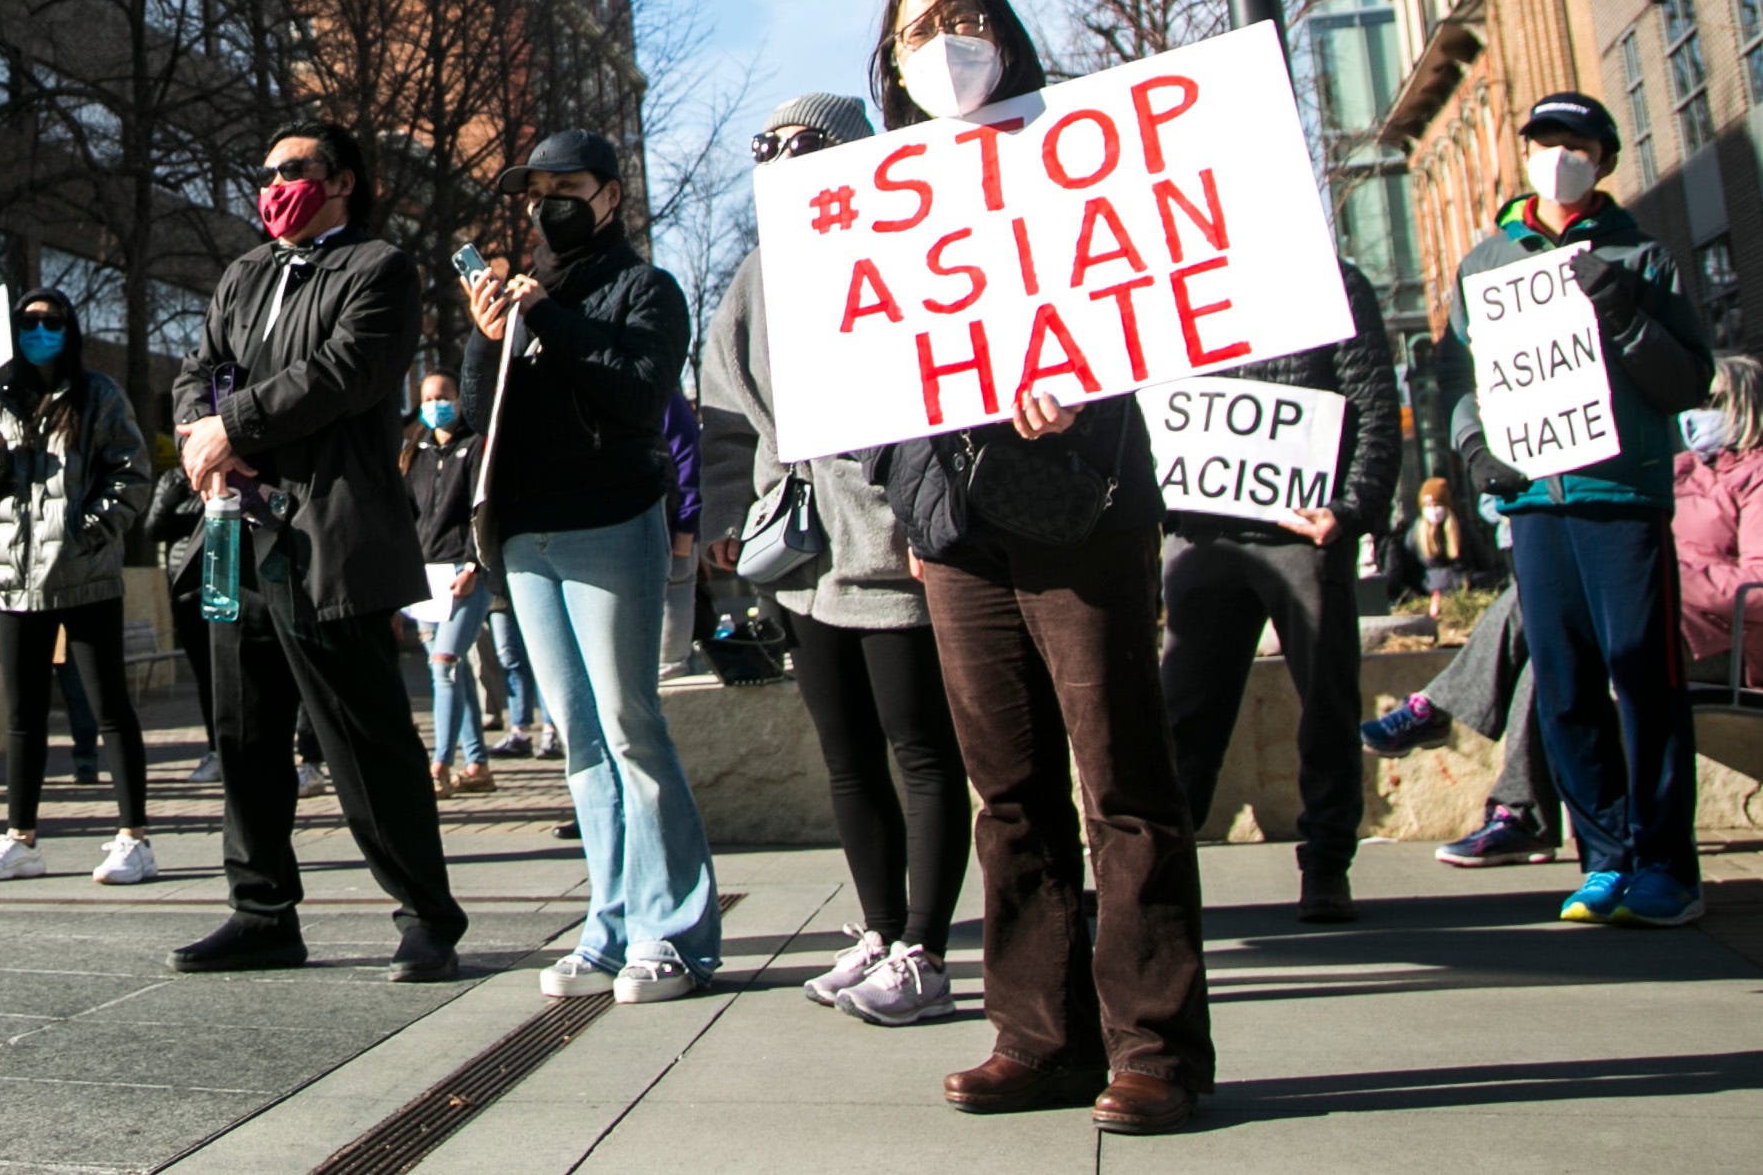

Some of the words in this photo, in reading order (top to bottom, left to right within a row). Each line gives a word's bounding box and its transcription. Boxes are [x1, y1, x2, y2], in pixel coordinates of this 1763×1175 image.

[808, 75, 1199, 234] #STOP
[839, 168, 1230, 334] ASIAN
[915, 255, 1252, 427] HATE
[1489, 326, 1597, 393] ASIAN
[1164, 390, 1304, 441] STOP
[1506, 399, 1607, 463] HATE
[1152, 455, 1330, 509] ACISM
